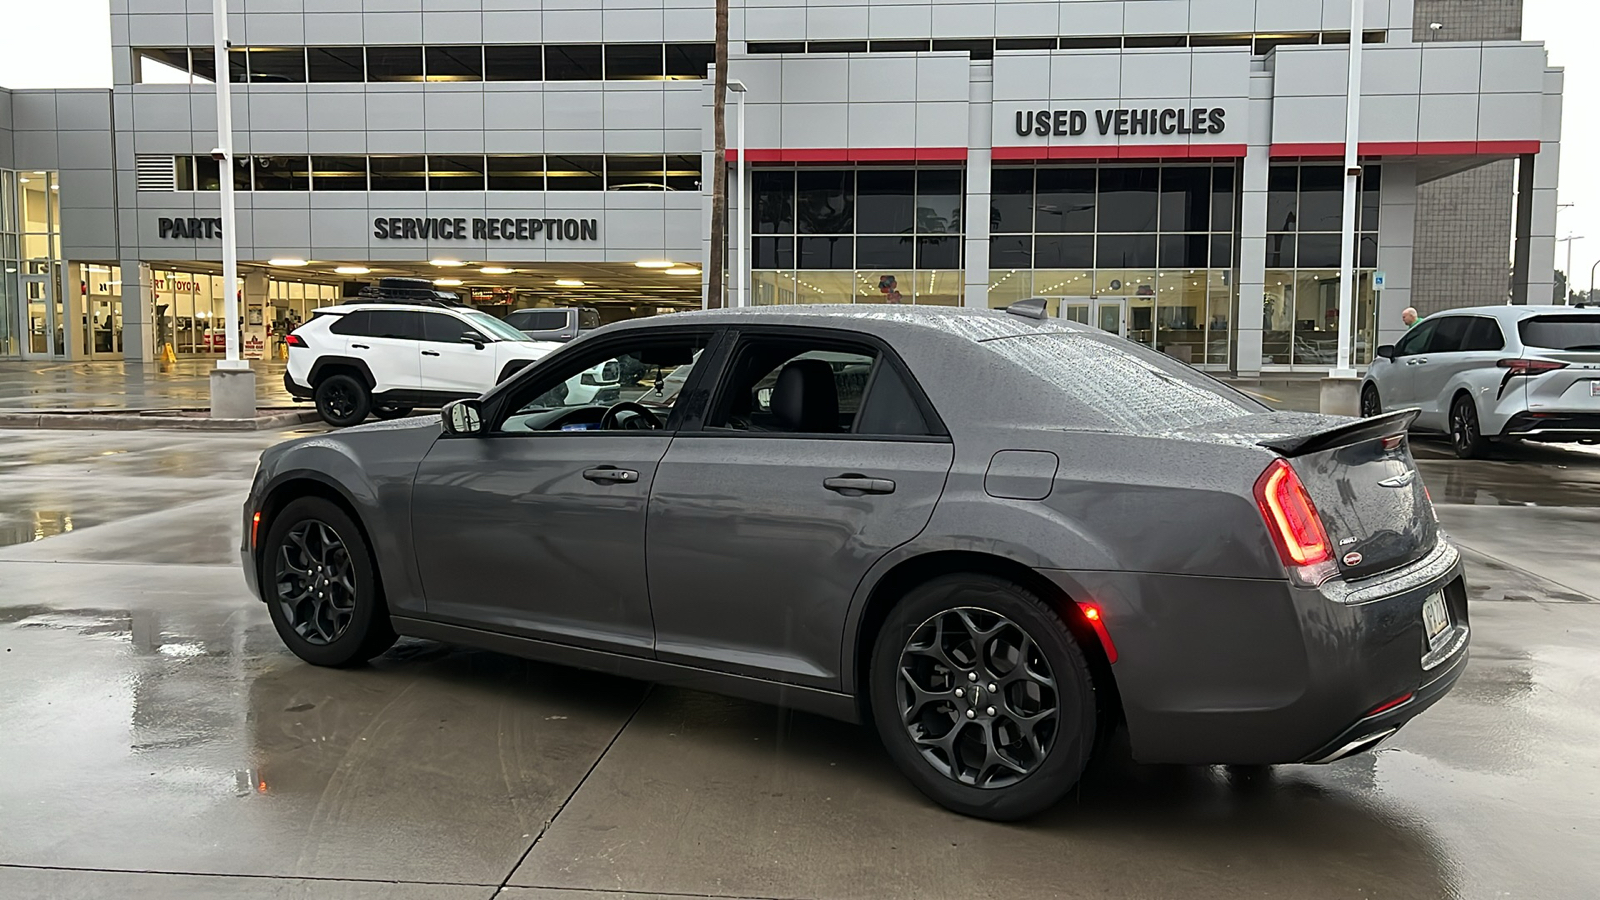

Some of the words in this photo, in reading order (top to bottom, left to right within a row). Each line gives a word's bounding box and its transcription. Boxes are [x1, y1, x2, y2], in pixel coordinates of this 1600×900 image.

[1015, 110, 1087, 137] USED
[1095, 108, 1226, 135] VEHICLES
[374, 217, 467, 240] SERVICE
[472, 217, 598, 241] RECEPTION
[174, 280, 201, 292] OYOA
